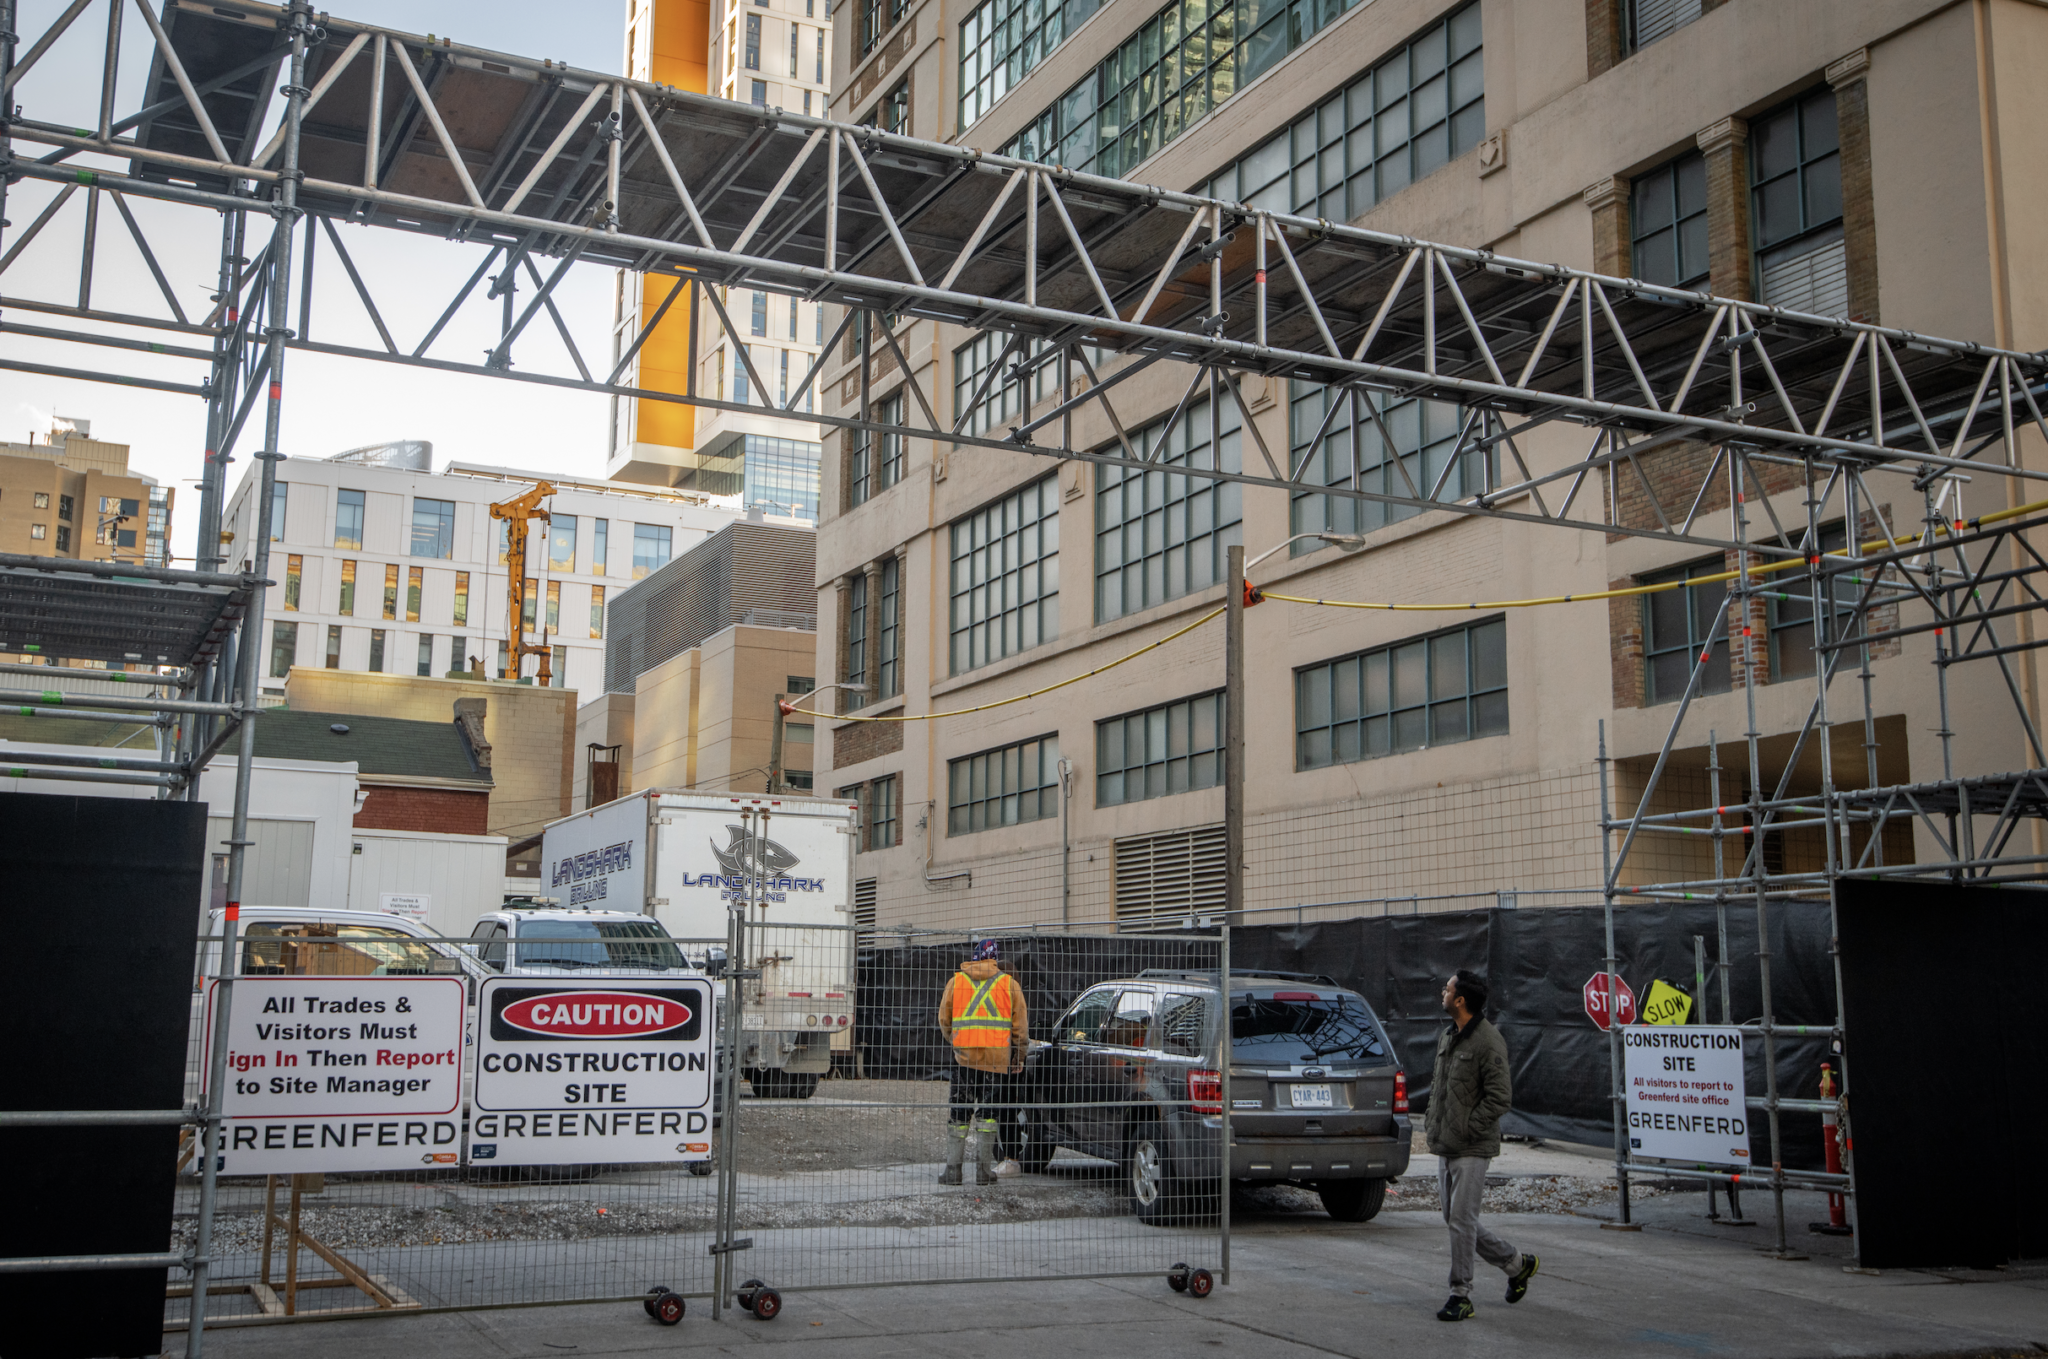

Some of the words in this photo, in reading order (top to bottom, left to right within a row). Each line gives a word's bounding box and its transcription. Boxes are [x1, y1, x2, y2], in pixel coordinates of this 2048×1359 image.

[552, 840, 633, 888] LANDSHARK
[570, 877, 608, 906] DRILLING
[682, 871, 826, 893] LANDSHARK
[720, 889, 787, 903] DRLLNG
[262, 996, 295, 1013] All
[303, 996, 387, 1013] Trades
[394, 996, 413, 1013] &
[530, 1003, 665, 1026] CAUTION
[1647, 994, 1685, 1022] SLOW
[256, 1023, 352, 1041] Visitors
[360, 1022, 418, 1040] Must
[1625, 1032, 1741, 1050] CONSTRUCTION
[226, 1050, 267, 1072] ign
[275, 1050, 299, 1068] In
[306, 1049, 368, 1067] Then
[375, 1048, 456, 1070] Report
[482, 1052, 706, 1073] CONSTRUCTION
[1662, 1055, 1697, 1072] SITE
[235, 1077, 261, 1095] to
[268, 1076, 319, 1094] Site
[326, 1075, 432, 1097] Manager
[563, 1083, 628, 1104] SITE
[1633, 1076, 1645, 1087] All
[1646, 1077, 1678, 1089] visitors
[1679, 1079, 1690, 1090] to
[1691, 1080, 1721, 1092] report
[1723, 1081, 1734, 1092] to
[1293, 1089, 1313, 1102] CYAR
[1316, 1089, 1331, 1102] 443
[1638, 1090, 1680, 1104] Greenferd
[1682, 1093, 1700, 1105] site
[1701, 1094, 1730, 1106] office
[474, 1111, 709, 1138] GREENFERD
[1629, 1111, 1745, 1136] GREENFERD
